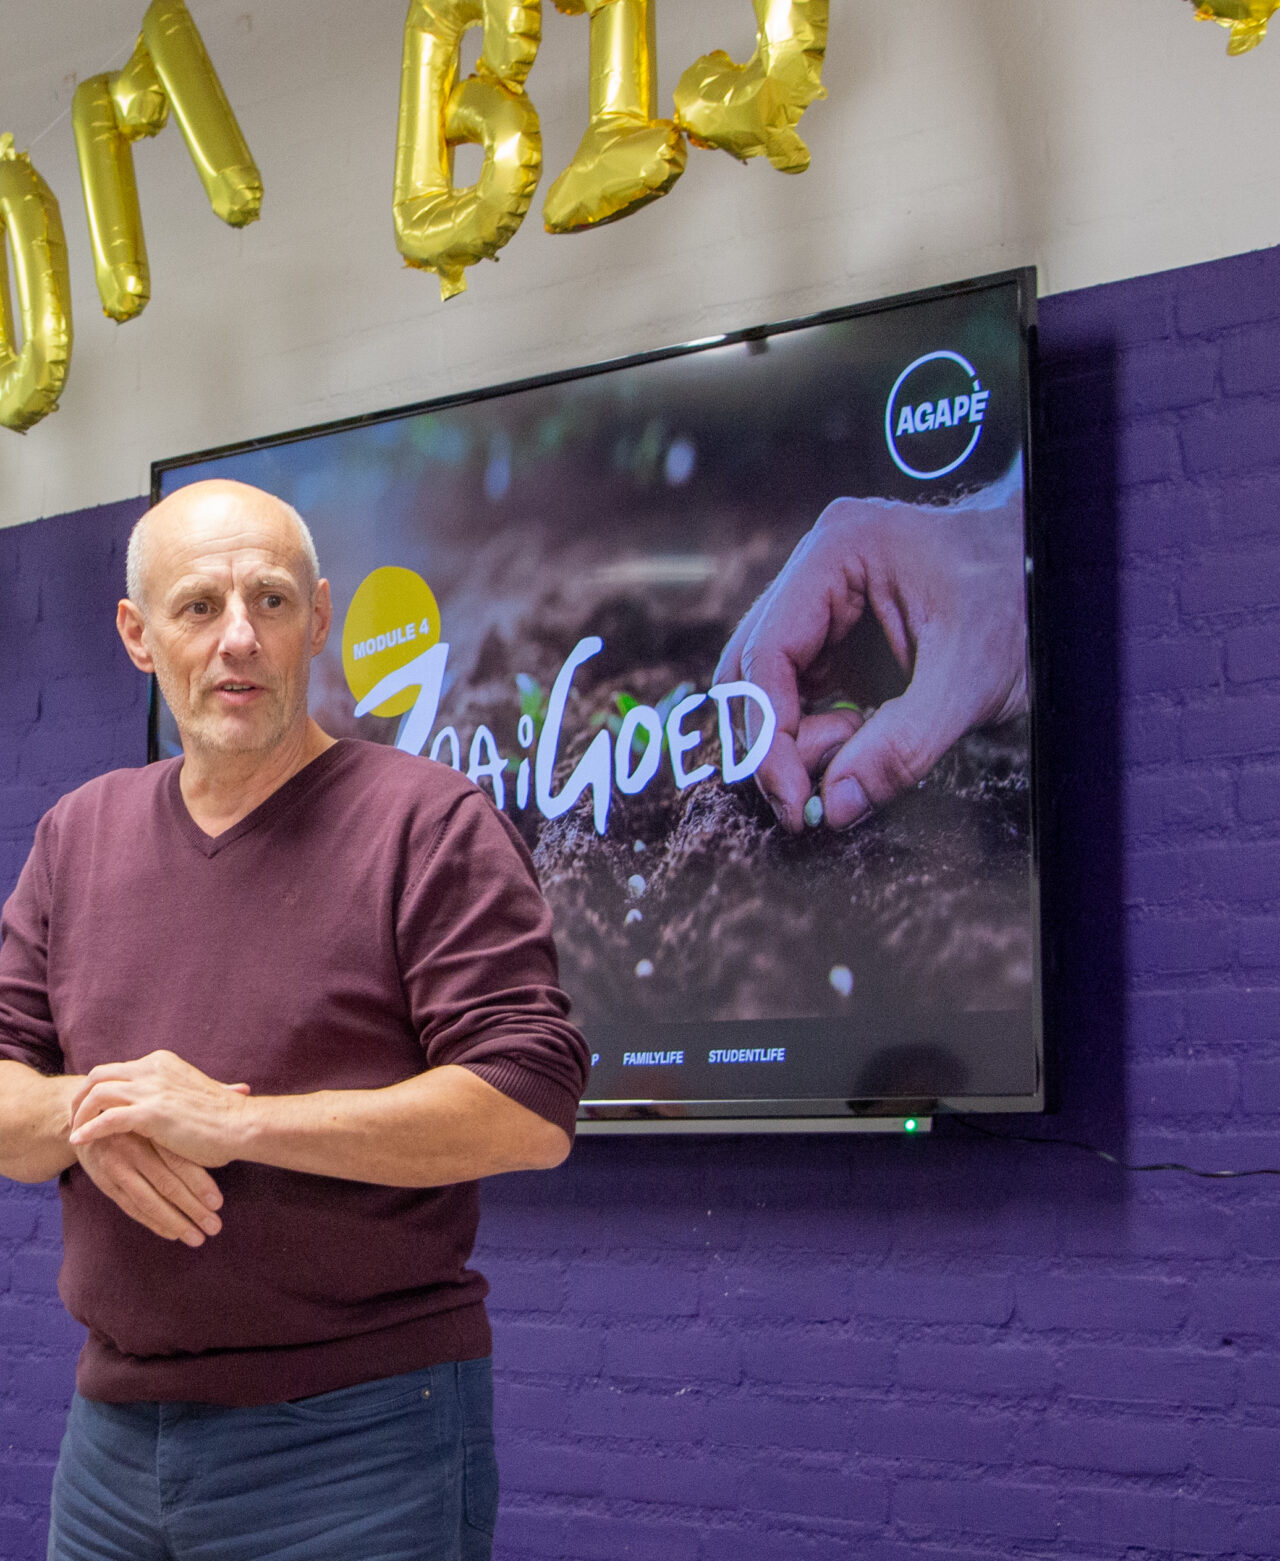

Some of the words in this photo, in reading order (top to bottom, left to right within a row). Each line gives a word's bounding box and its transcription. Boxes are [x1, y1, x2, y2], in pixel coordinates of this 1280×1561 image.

[352, 622, 417, 661] MODULE
[418, 617, 430, 635] 4
[622, 1050, 685, 1066] FAMILYLIFE
[707, 1047, 786, 1064] STUDENTLIFE
